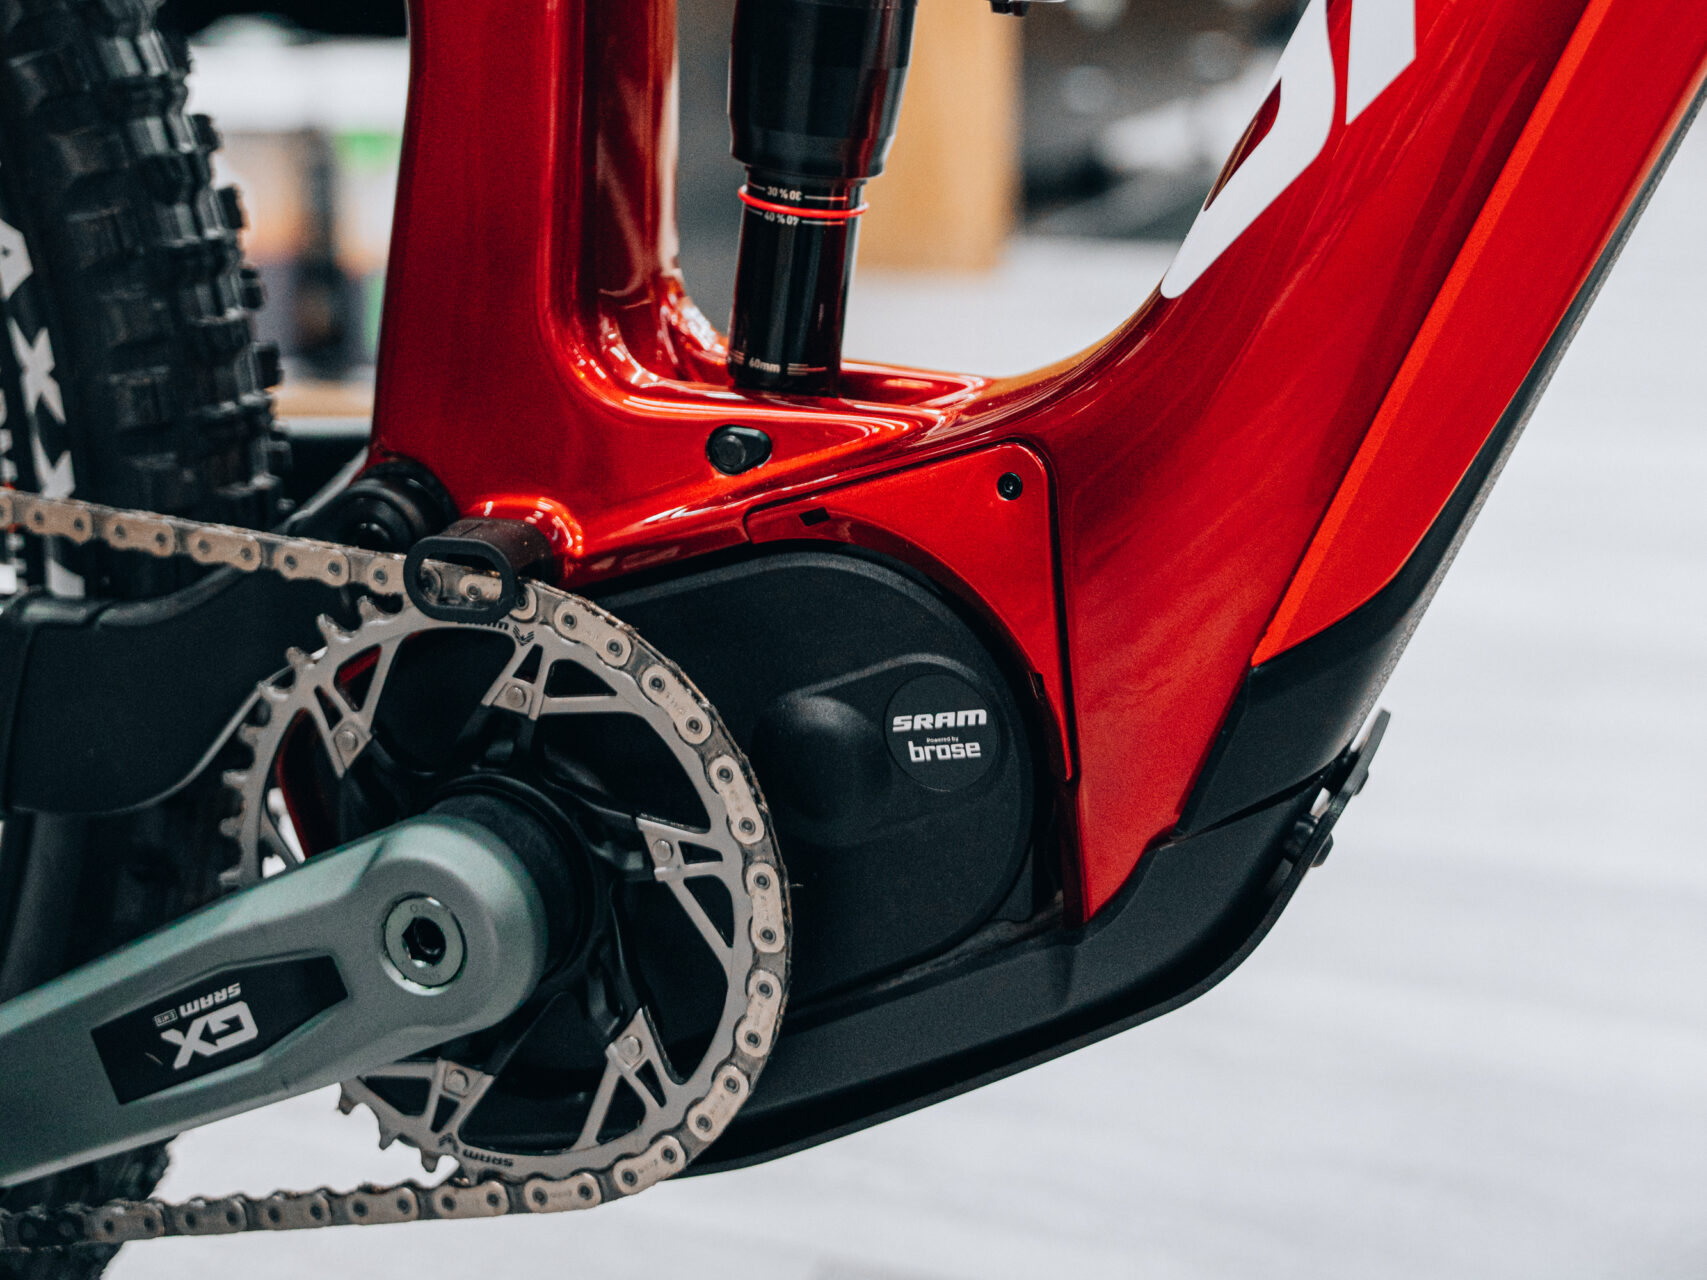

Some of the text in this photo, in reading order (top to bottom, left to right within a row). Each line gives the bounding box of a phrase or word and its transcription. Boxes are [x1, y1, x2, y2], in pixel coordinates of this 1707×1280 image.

[893, 708, 987, 732] SRAM
[908, 740, 981, 762] brose
[179, 982, 241, 1018] SRAM
[160, 1000, 259, 1070] GX
[463, 1149, 514, 1167] SRAM
